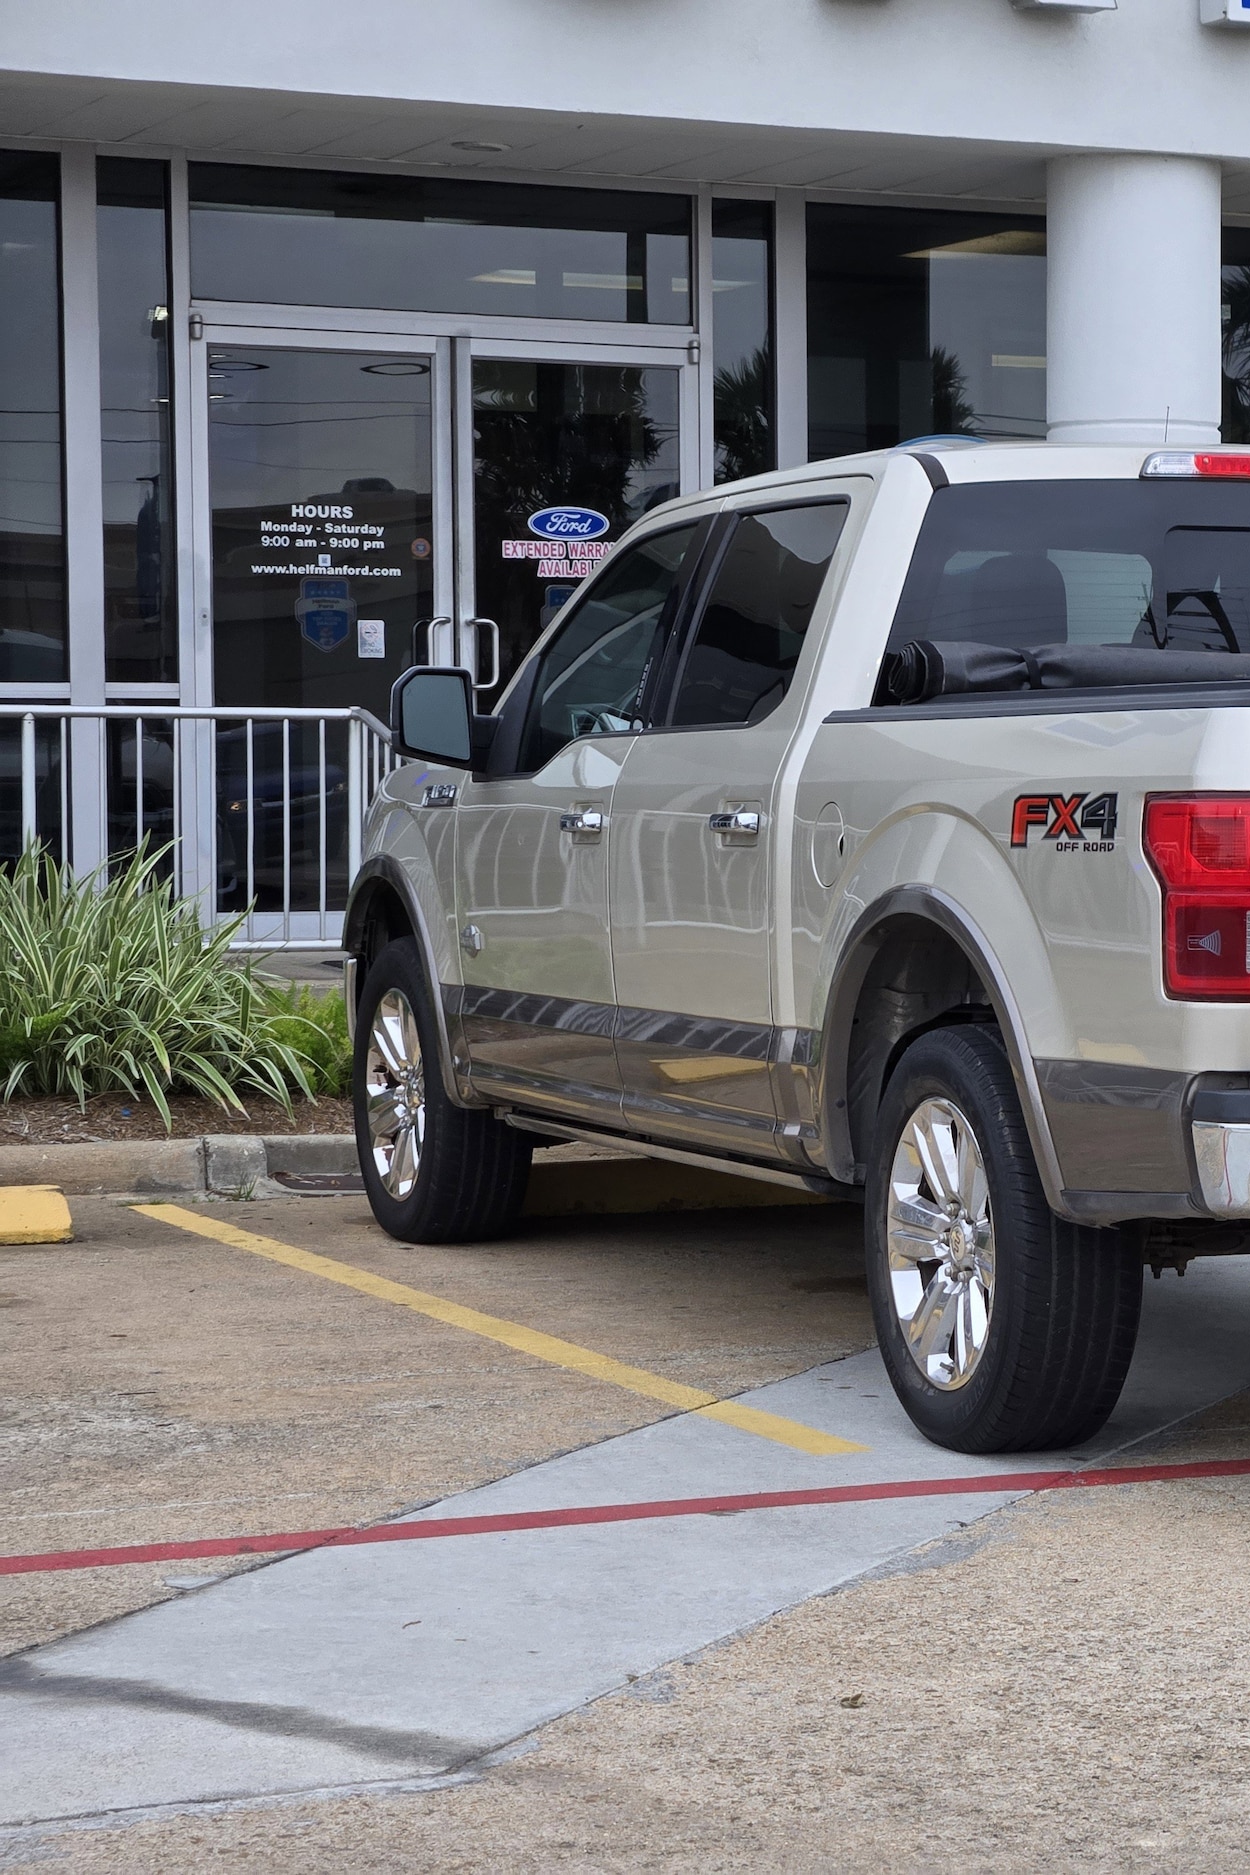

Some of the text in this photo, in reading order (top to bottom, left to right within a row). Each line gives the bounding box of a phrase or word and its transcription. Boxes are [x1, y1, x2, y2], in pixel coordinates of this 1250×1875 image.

[291, 504, 353, 519] HOURS
[260, 521, 313, 535] Monday
[325, 523, 385, 537] Saturday
[546, 513, 592, 533] Ford
[261, 535, 290, 547] 9:00
[295, 537, 317, 547] am
[329, 537, 360, 548] 9:00
[363, 539, 385, 550] pm
[503, 541, 615, 559] EXTENDED WARRA
[251, 564, 401, 576] www.helfmanford.com
[537, 560, 601, 577] AVAILABL
[1010, 791, 1119, 849] FX4
[1056, 842, 1115, 852] OFF ROAD
